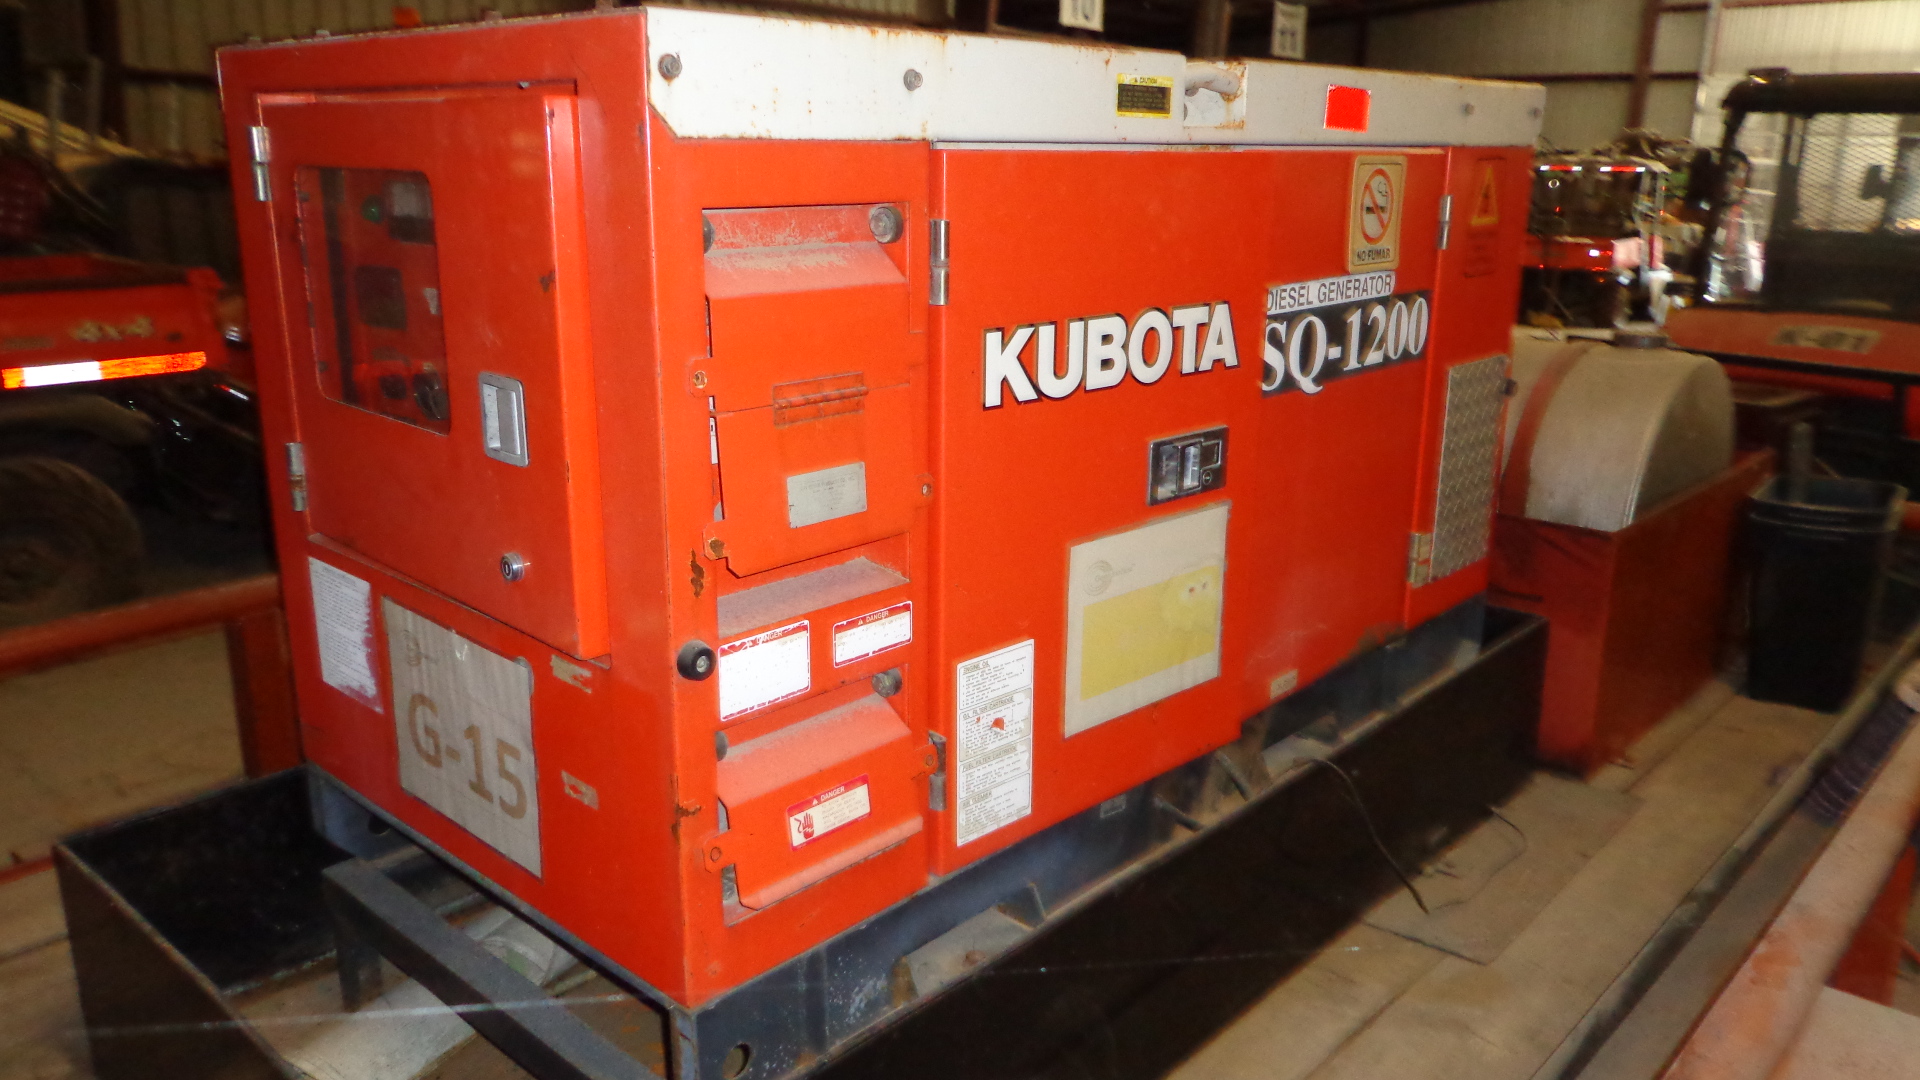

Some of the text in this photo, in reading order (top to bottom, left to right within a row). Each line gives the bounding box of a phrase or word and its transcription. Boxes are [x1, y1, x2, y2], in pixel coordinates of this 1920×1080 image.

[1356, 248, 1391, 262] NO FUMAR
[1267, 274, 1392, 312] DIESEL GENERATOR
[1262, 294, 1429, 395] SQ-1200
[982, 301, 1240, 412] KUBOTA
[865, 610, 889, 623] DANGER
[756, 630, 784, 645] DANGER
[963, 662, 980, 674] ENGINE
[407, 693, 528, 820] G-15
[820, 785, 845, 802] DANGER
